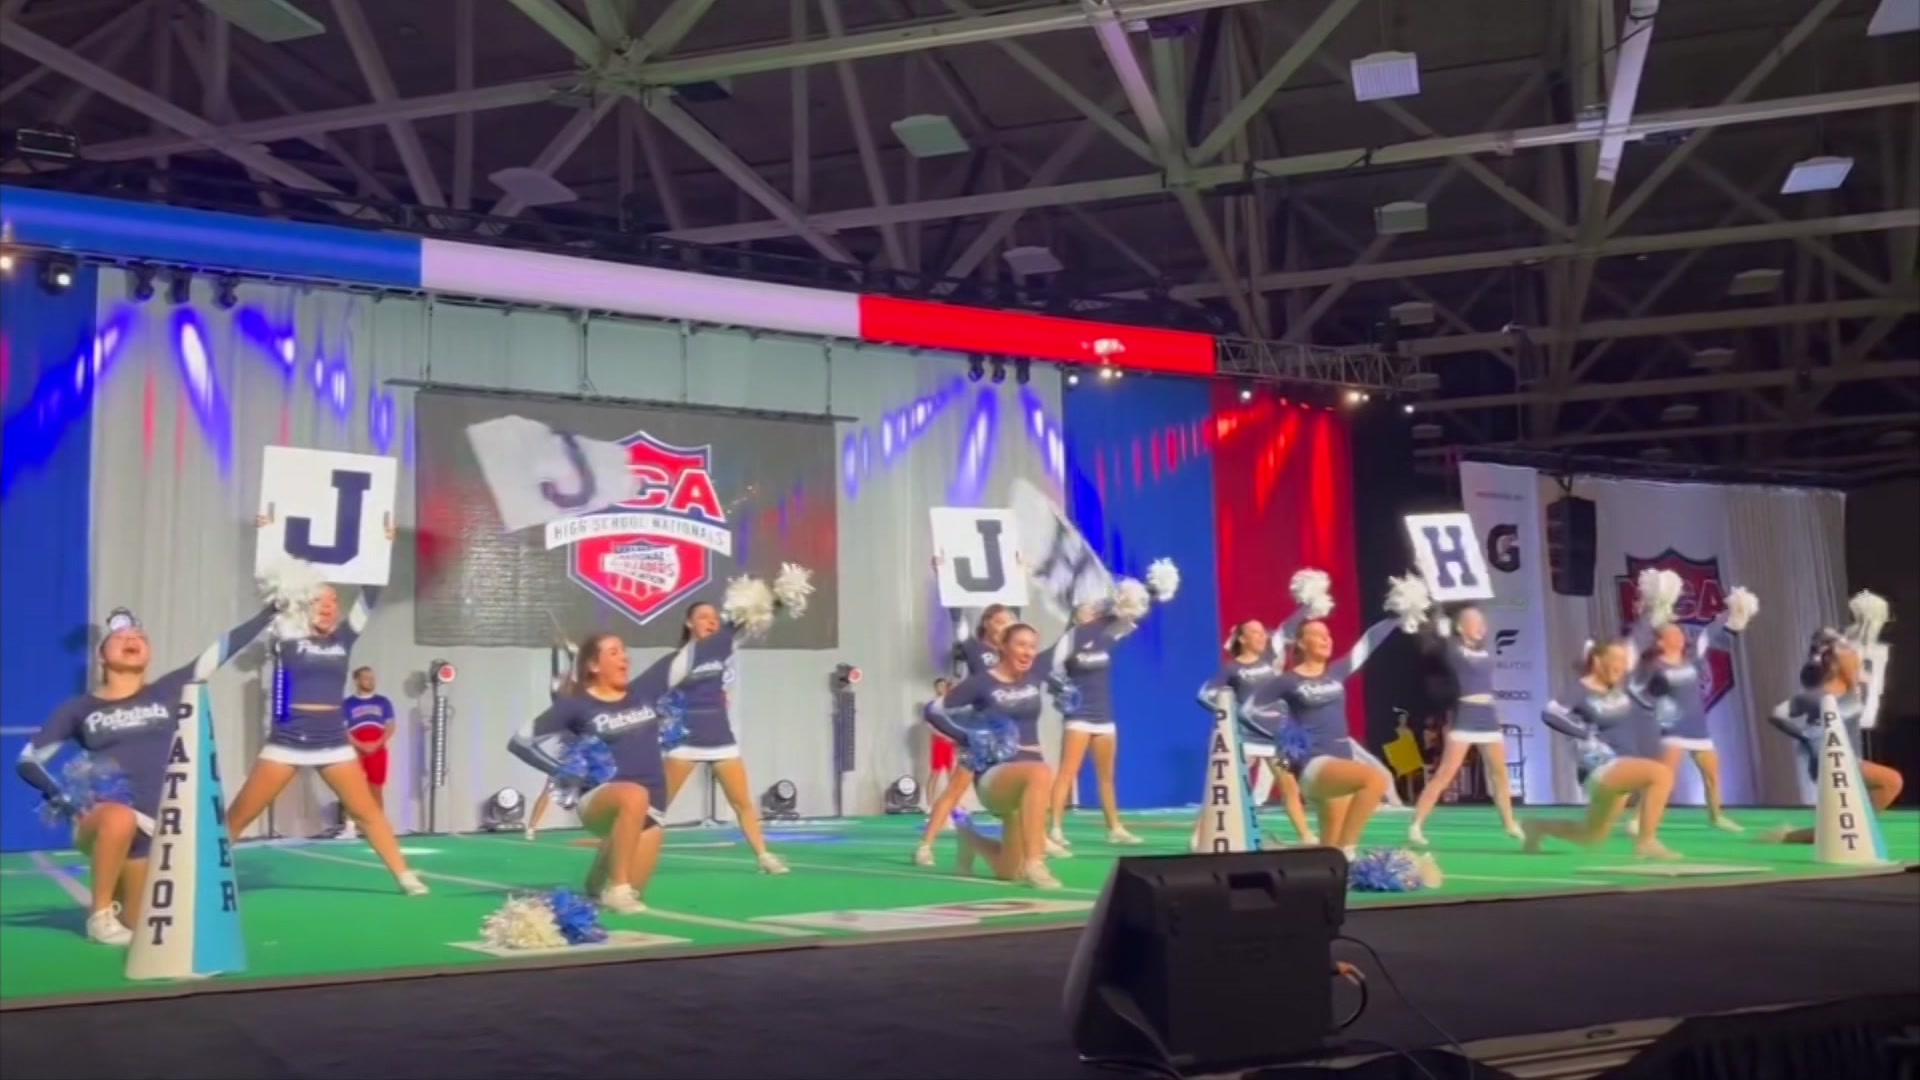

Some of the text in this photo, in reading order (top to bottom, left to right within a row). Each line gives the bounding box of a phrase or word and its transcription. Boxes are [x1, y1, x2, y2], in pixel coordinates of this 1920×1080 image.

[284, 469, 372, 566] J
[554, 515, 725, 547] HIGH SCHOOL NATIONALS
[953, 519, 1005, 592] J
[1423, 525, 1479, 588] H
[1487, 523, 1521, 573] G
[1211, 709, 1230, 853] PATRIO
[1823, 711, 1859, 851] PATRIOT
[148, 703, 193, 946] PATRIOT
